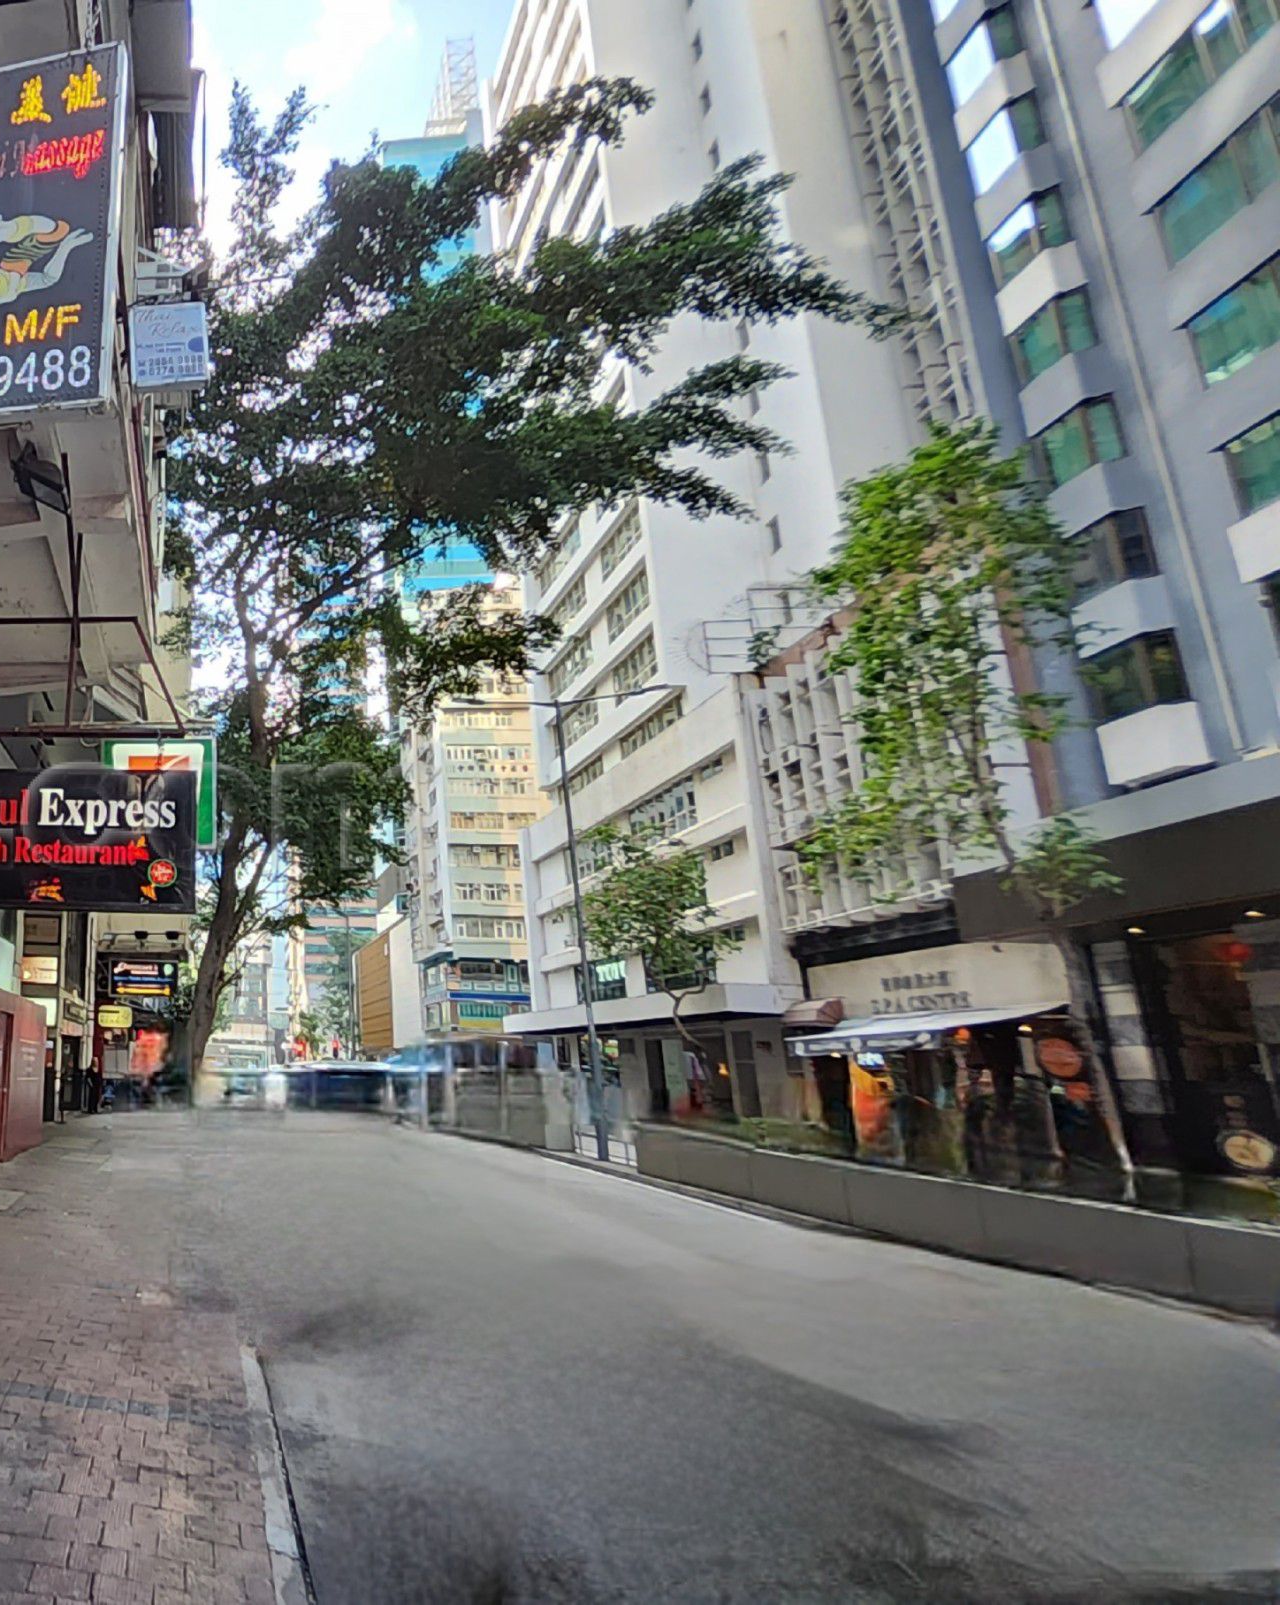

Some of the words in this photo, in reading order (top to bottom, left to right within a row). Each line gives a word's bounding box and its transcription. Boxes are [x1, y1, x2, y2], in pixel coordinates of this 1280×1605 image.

[3, 303, 82, 347] M/F
[37, 787, 176, 836] Express
[14, 835, 137, 867] Restaurant
